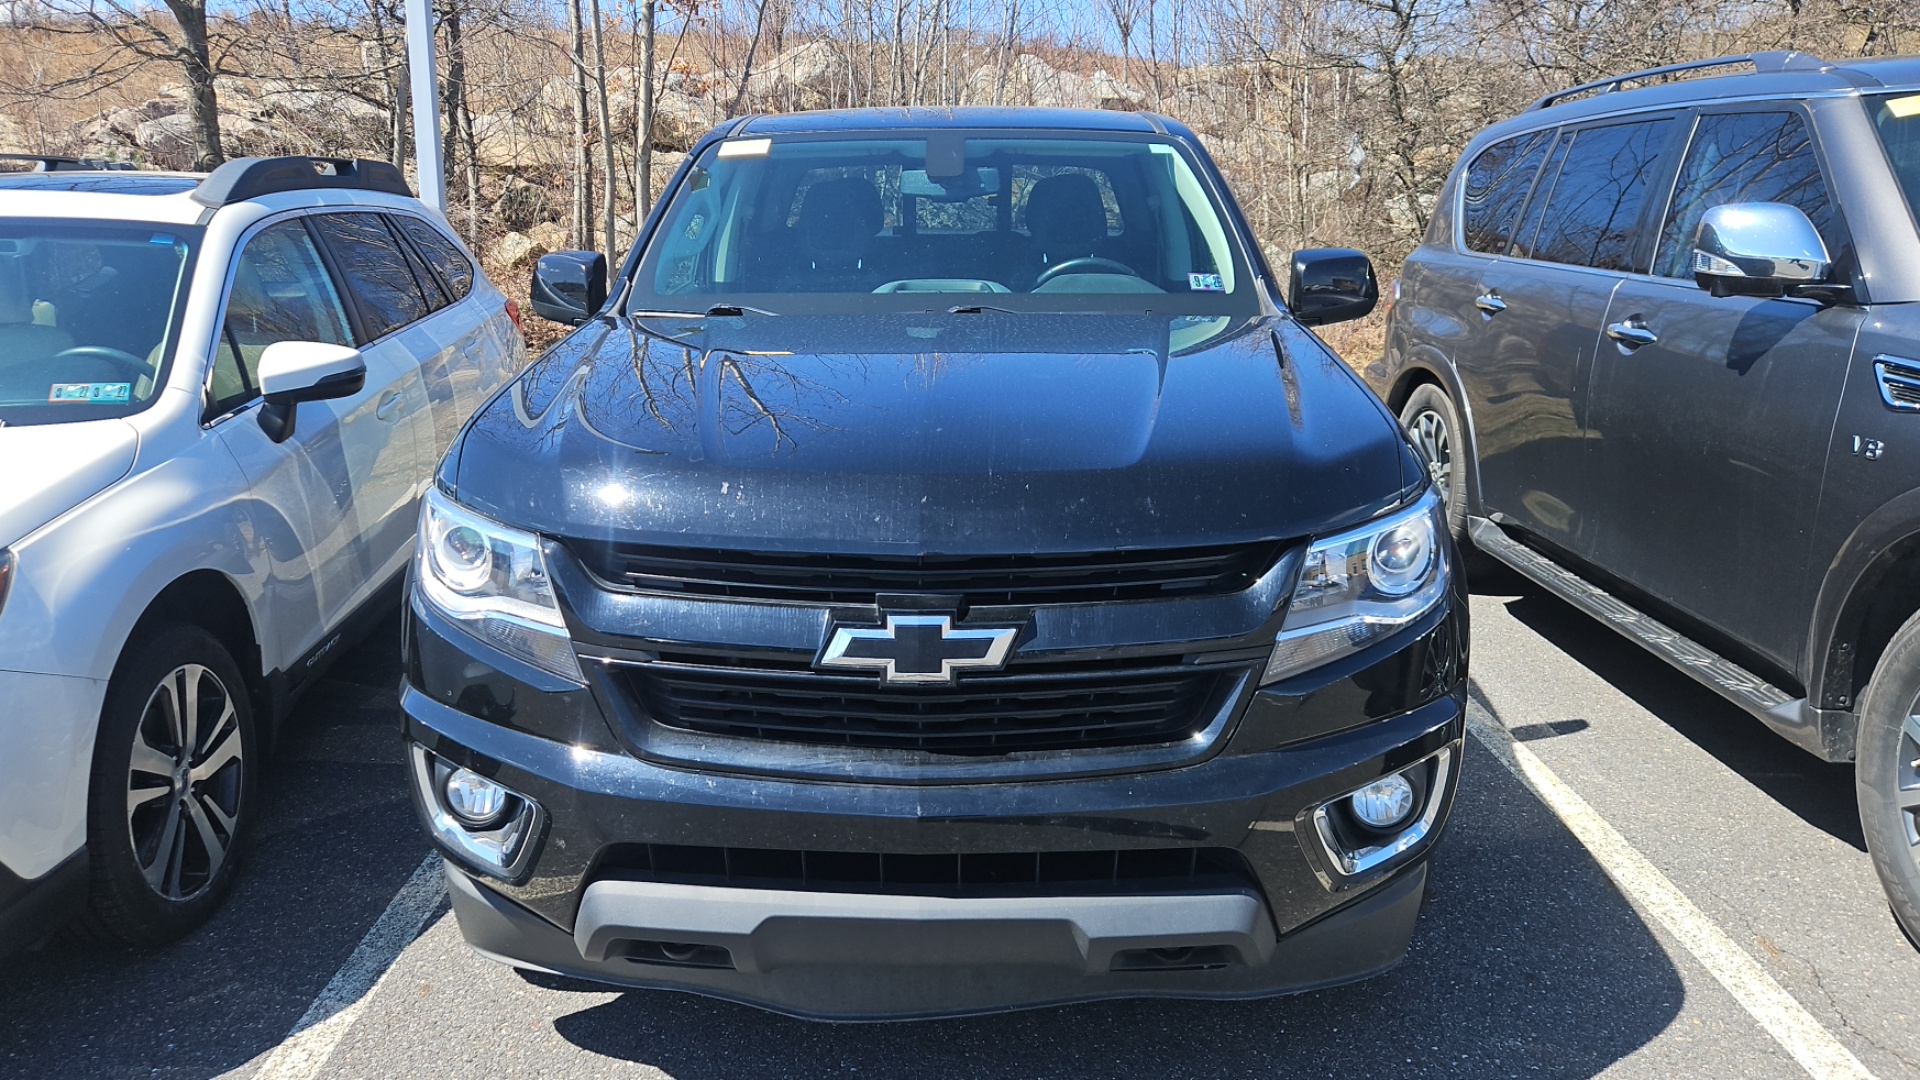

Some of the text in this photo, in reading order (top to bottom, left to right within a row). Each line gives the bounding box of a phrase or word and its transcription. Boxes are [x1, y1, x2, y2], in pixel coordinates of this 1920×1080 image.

[55, 387, 63, 398] 3
[93, 387, 100, 398] 3
[1852, 434, 1885, 460] V8
